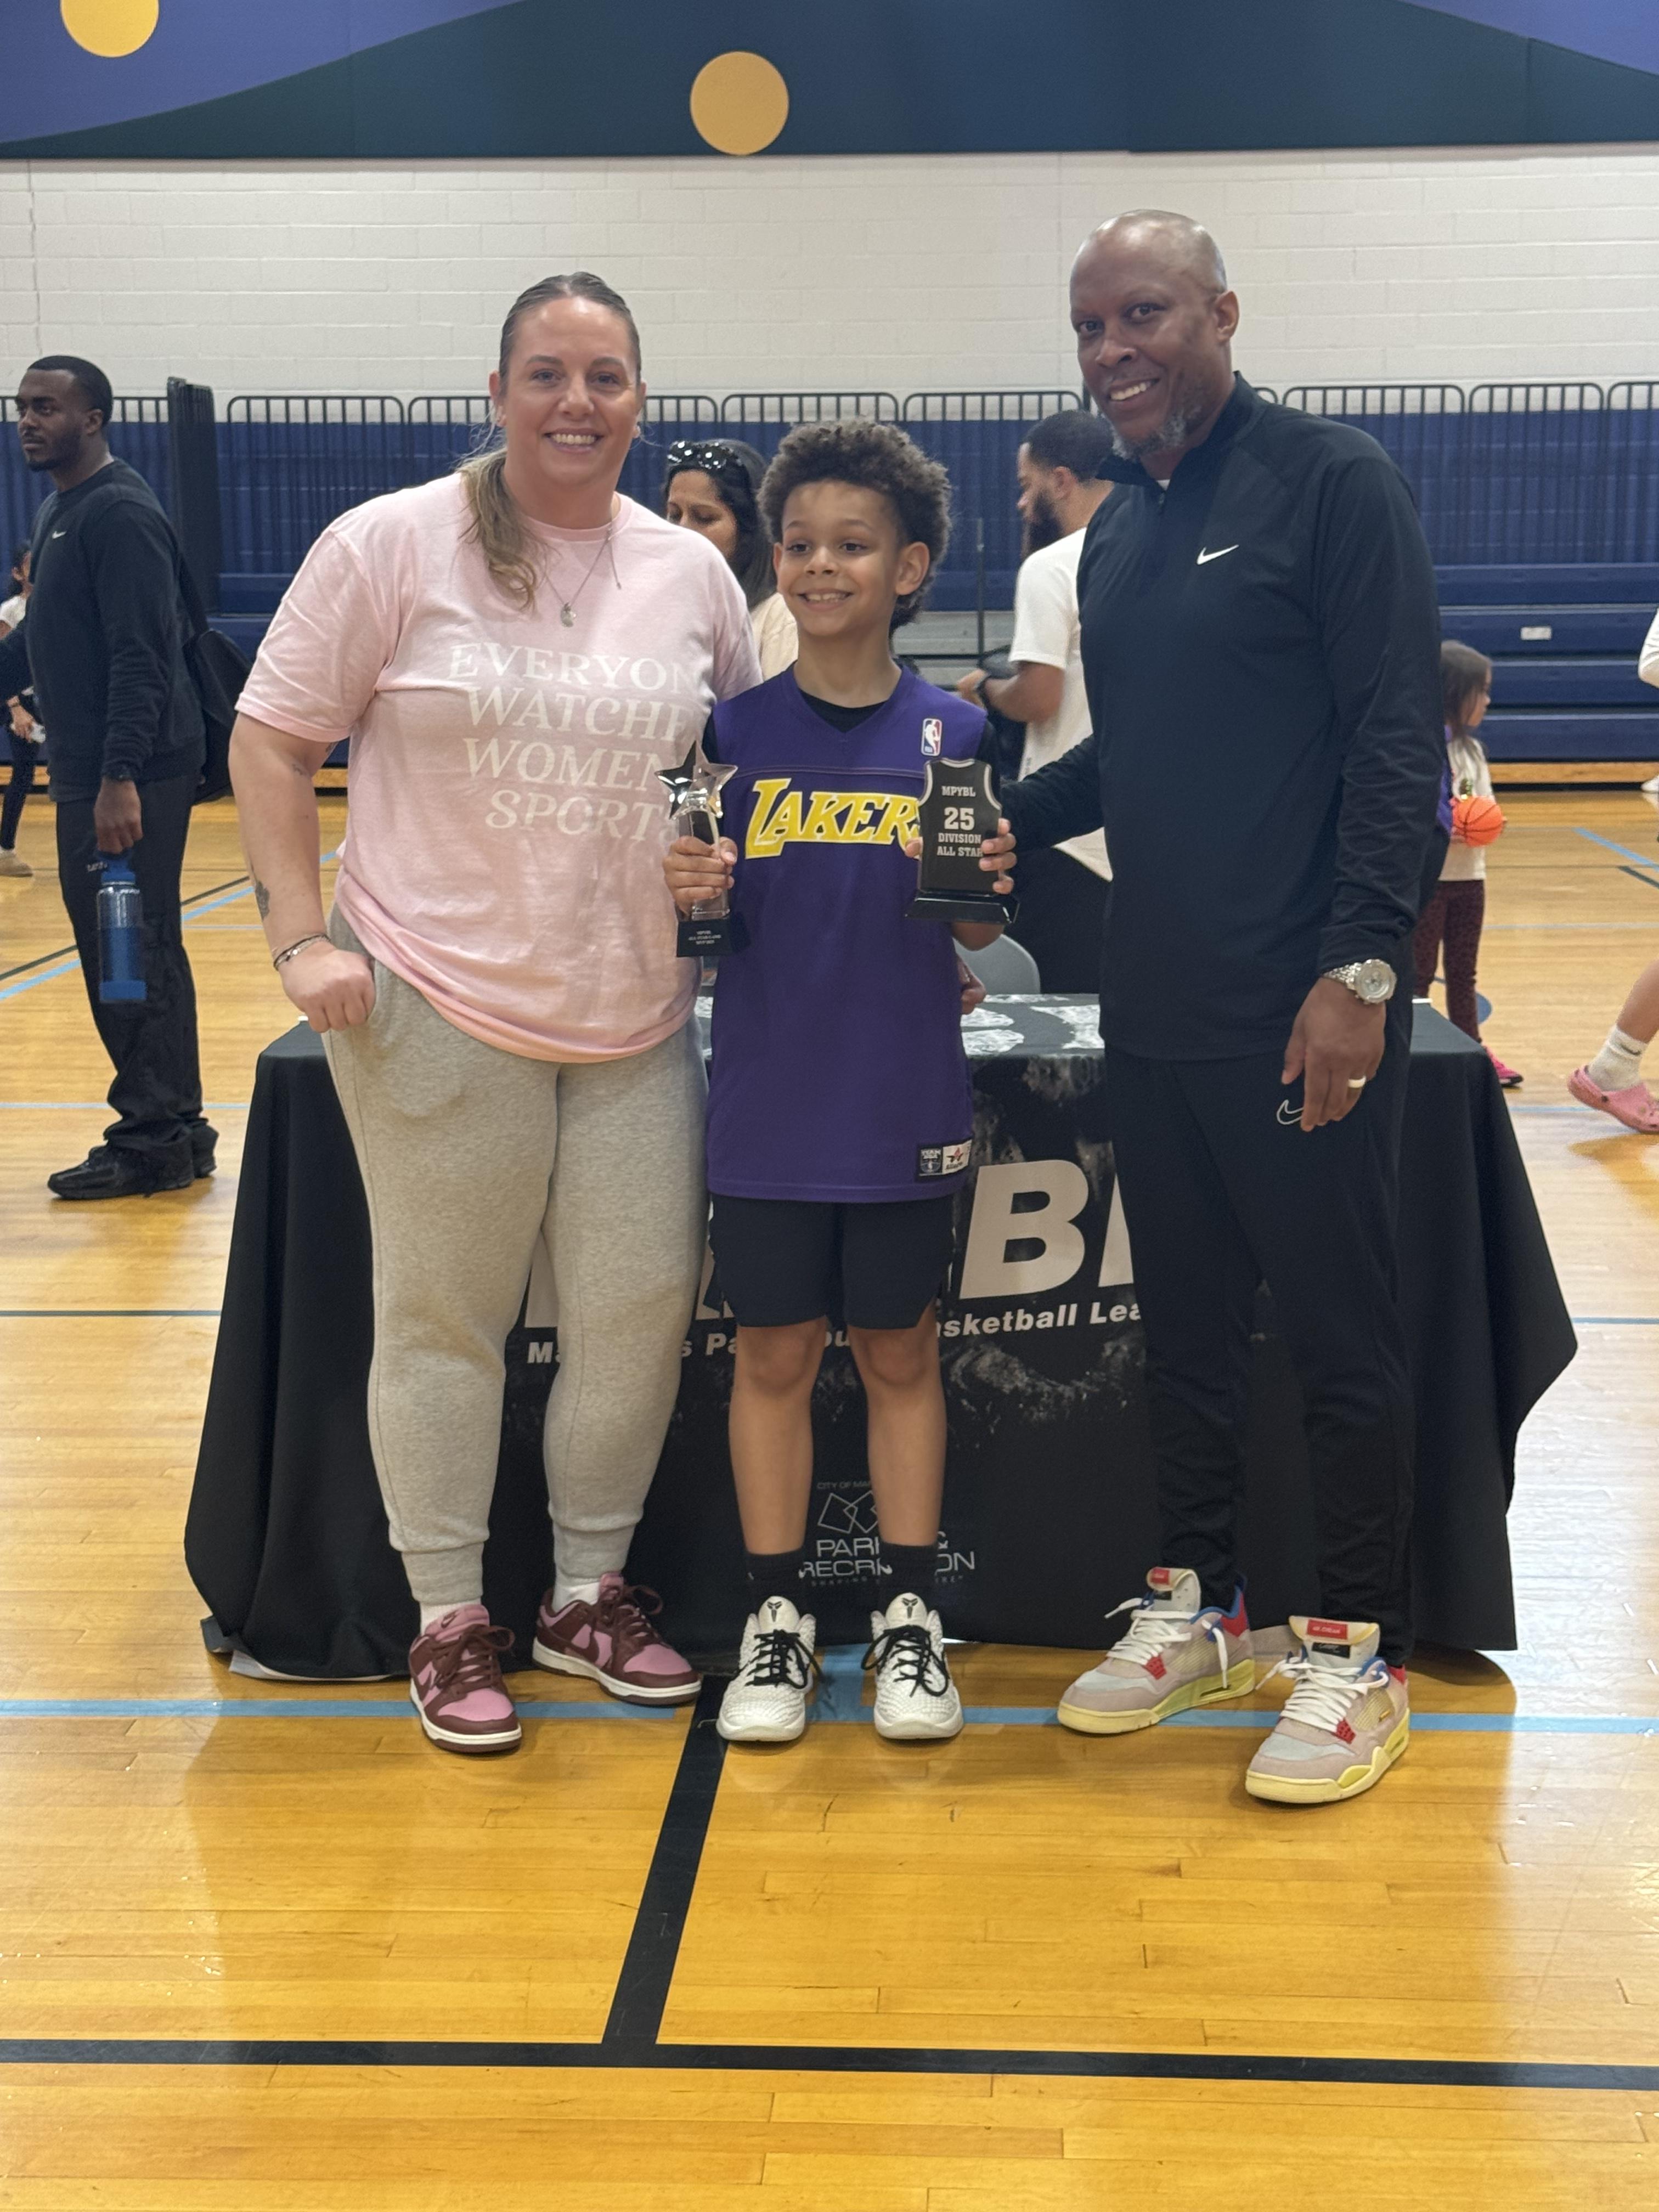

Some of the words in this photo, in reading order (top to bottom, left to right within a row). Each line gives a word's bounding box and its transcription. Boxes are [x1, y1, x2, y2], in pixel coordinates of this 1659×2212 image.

[941, 786, 976, 797] MPYBL
[745, 778, 919, 860] LAKER
[944, 807, 974, 831] 25
[938, 833, 981, 844] DIVISION
[936, 845, 956, 856] ALL
